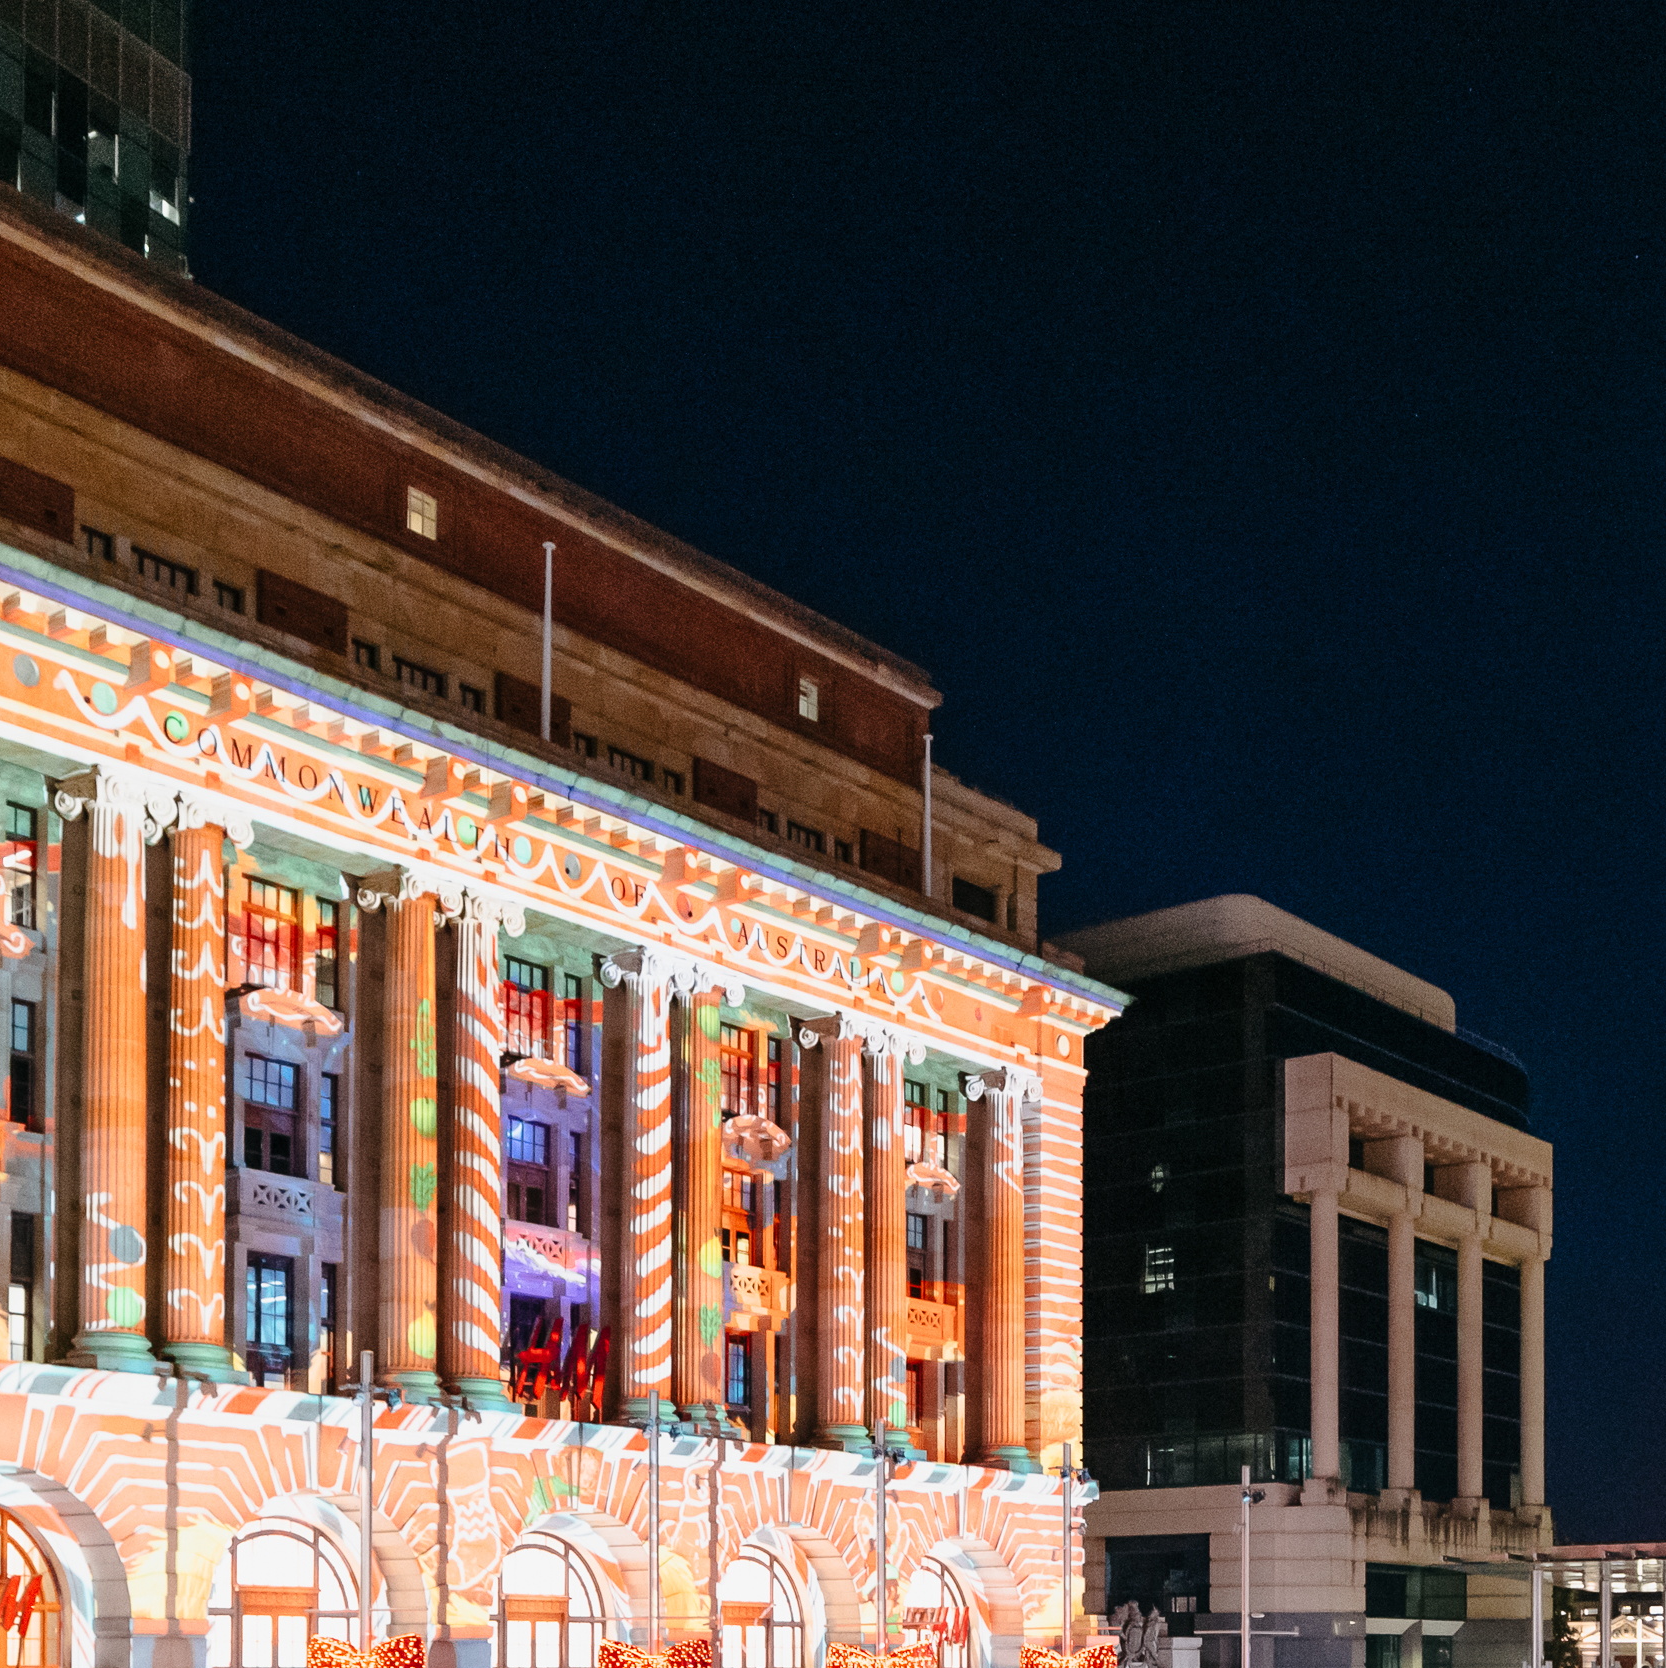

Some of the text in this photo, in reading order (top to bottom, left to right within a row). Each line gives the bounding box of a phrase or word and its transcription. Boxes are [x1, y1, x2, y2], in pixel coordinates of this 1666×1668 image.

[162, 714, 889, 995] COMMONWEALTH OF AUSTRALIA
